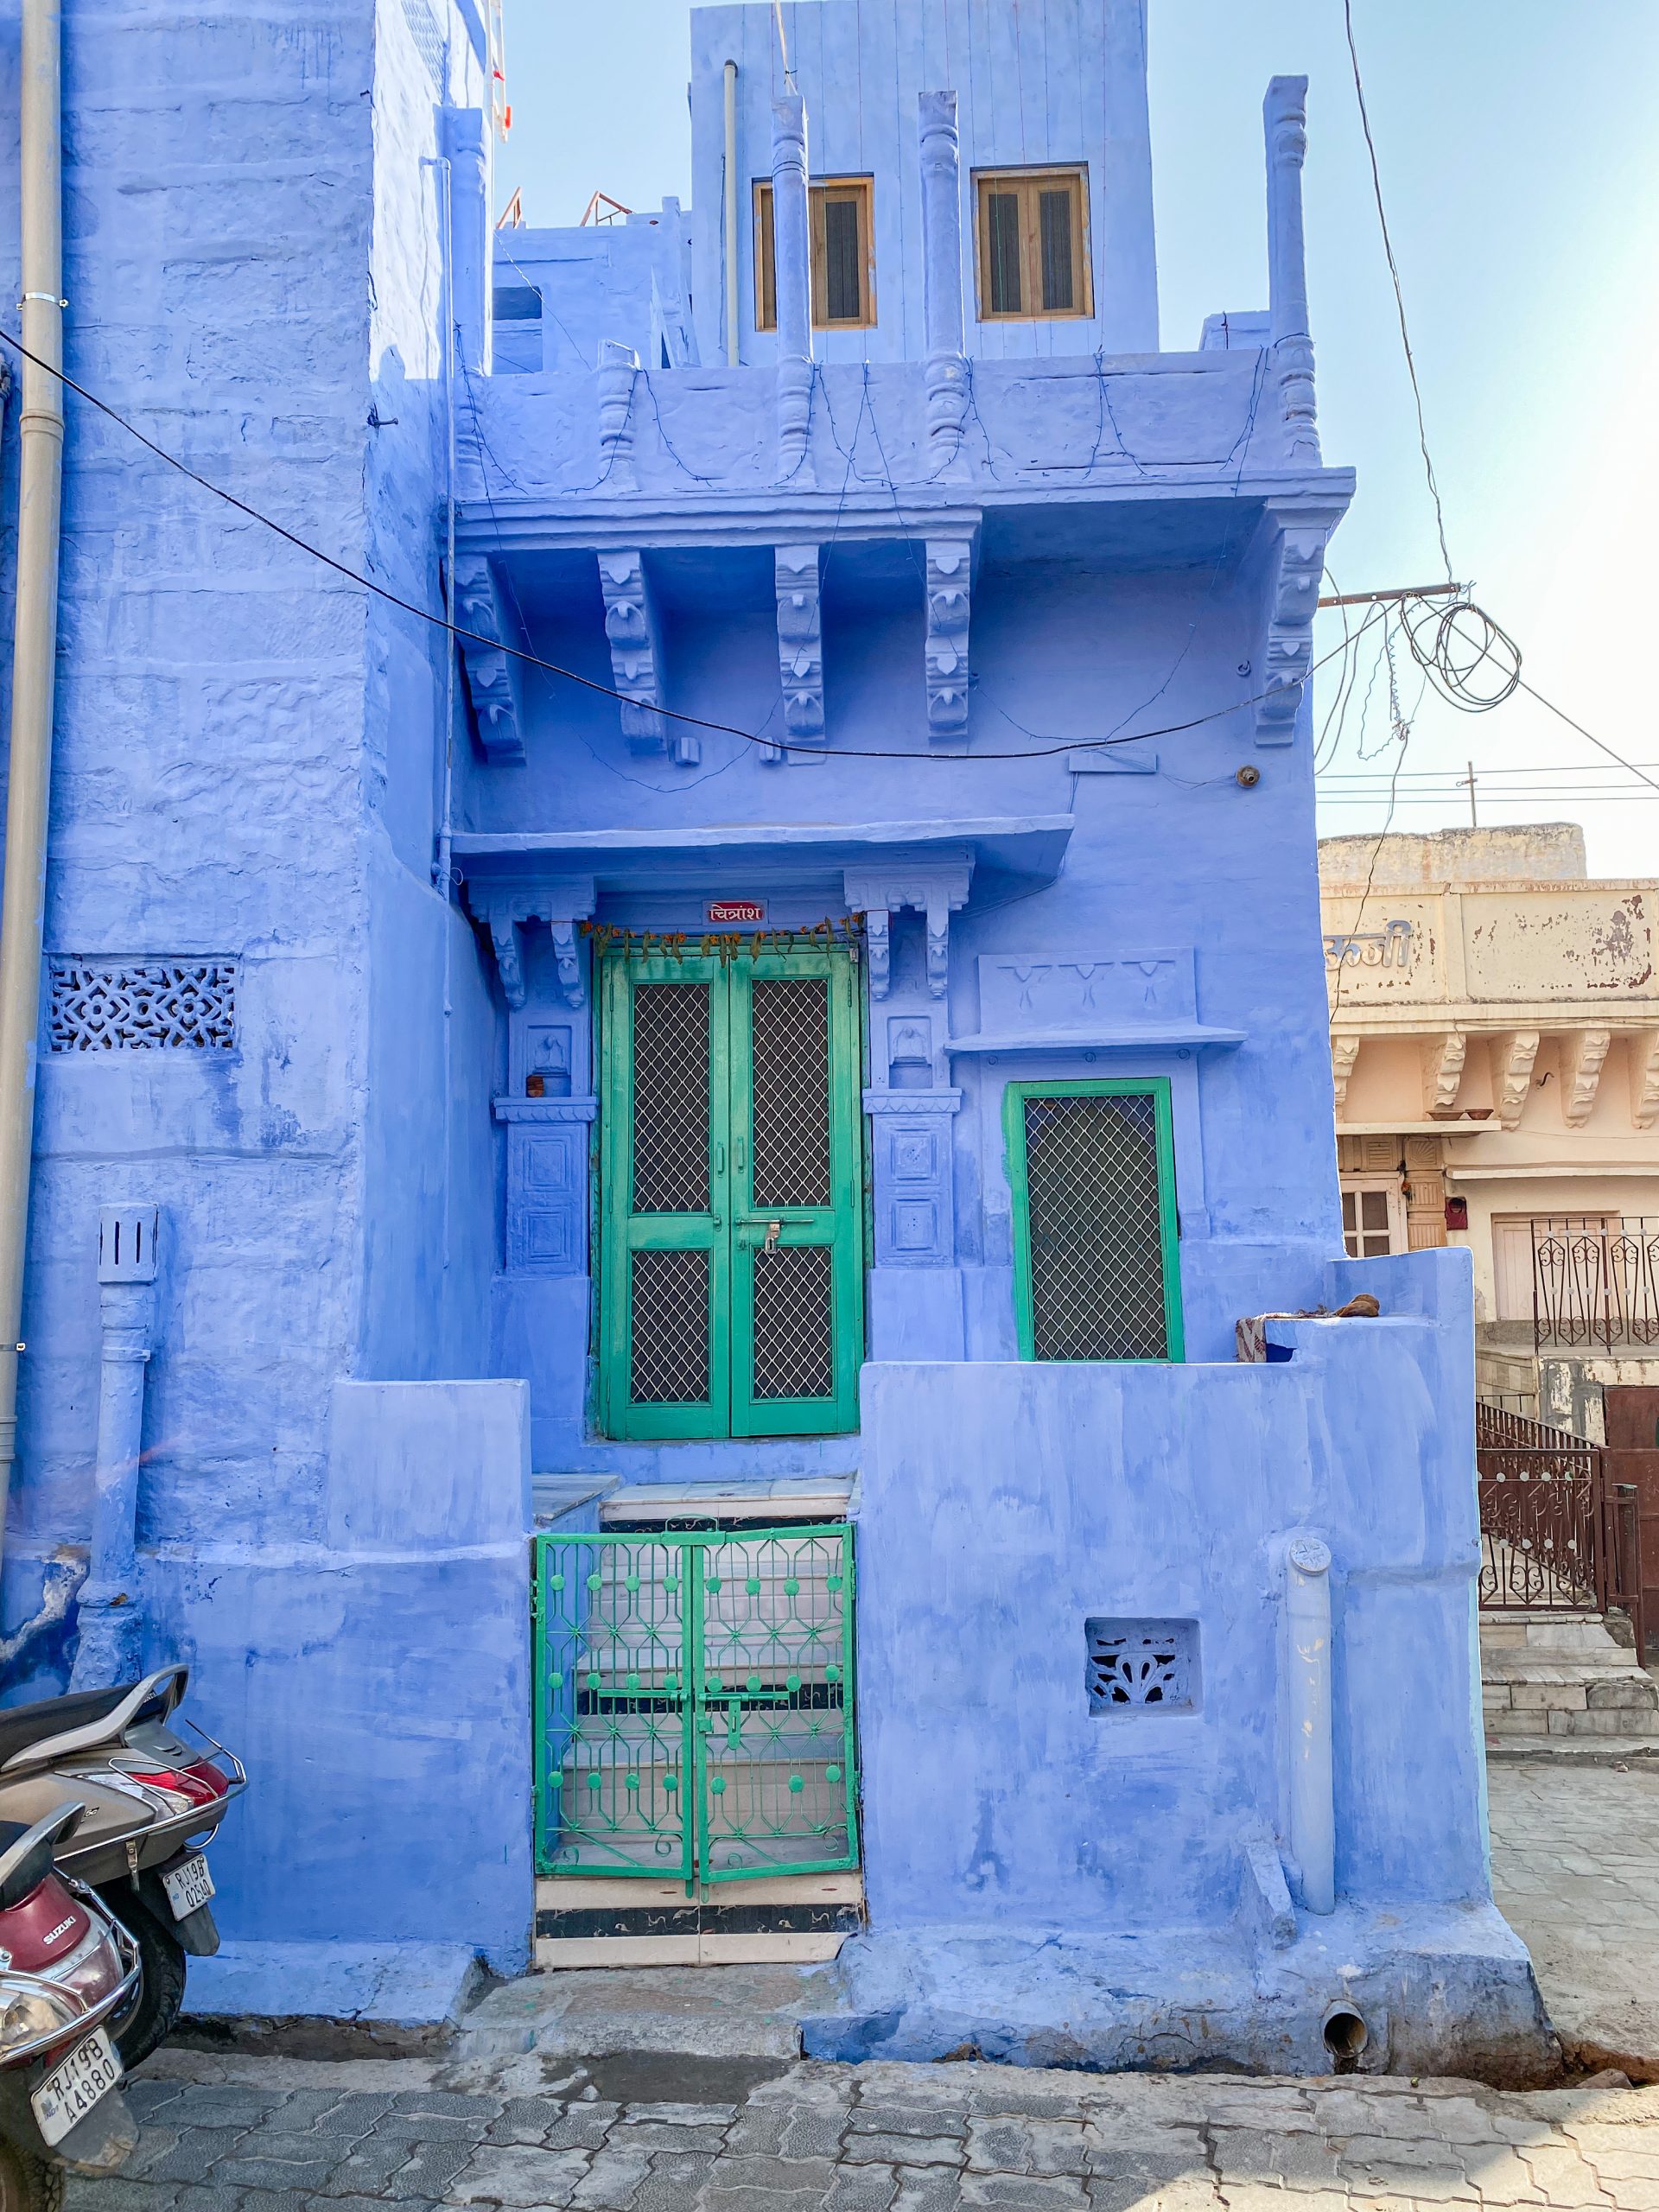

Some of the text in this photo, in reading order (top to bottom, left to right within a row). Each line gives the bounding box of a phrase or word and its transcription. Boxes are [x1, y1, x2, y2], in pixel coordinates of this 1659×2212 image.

[709, 903, 761, 920] चित्रांश
[42, 1915, 77, 1945] SUZUKI
[64, 2058, 115, 2124] A4880
